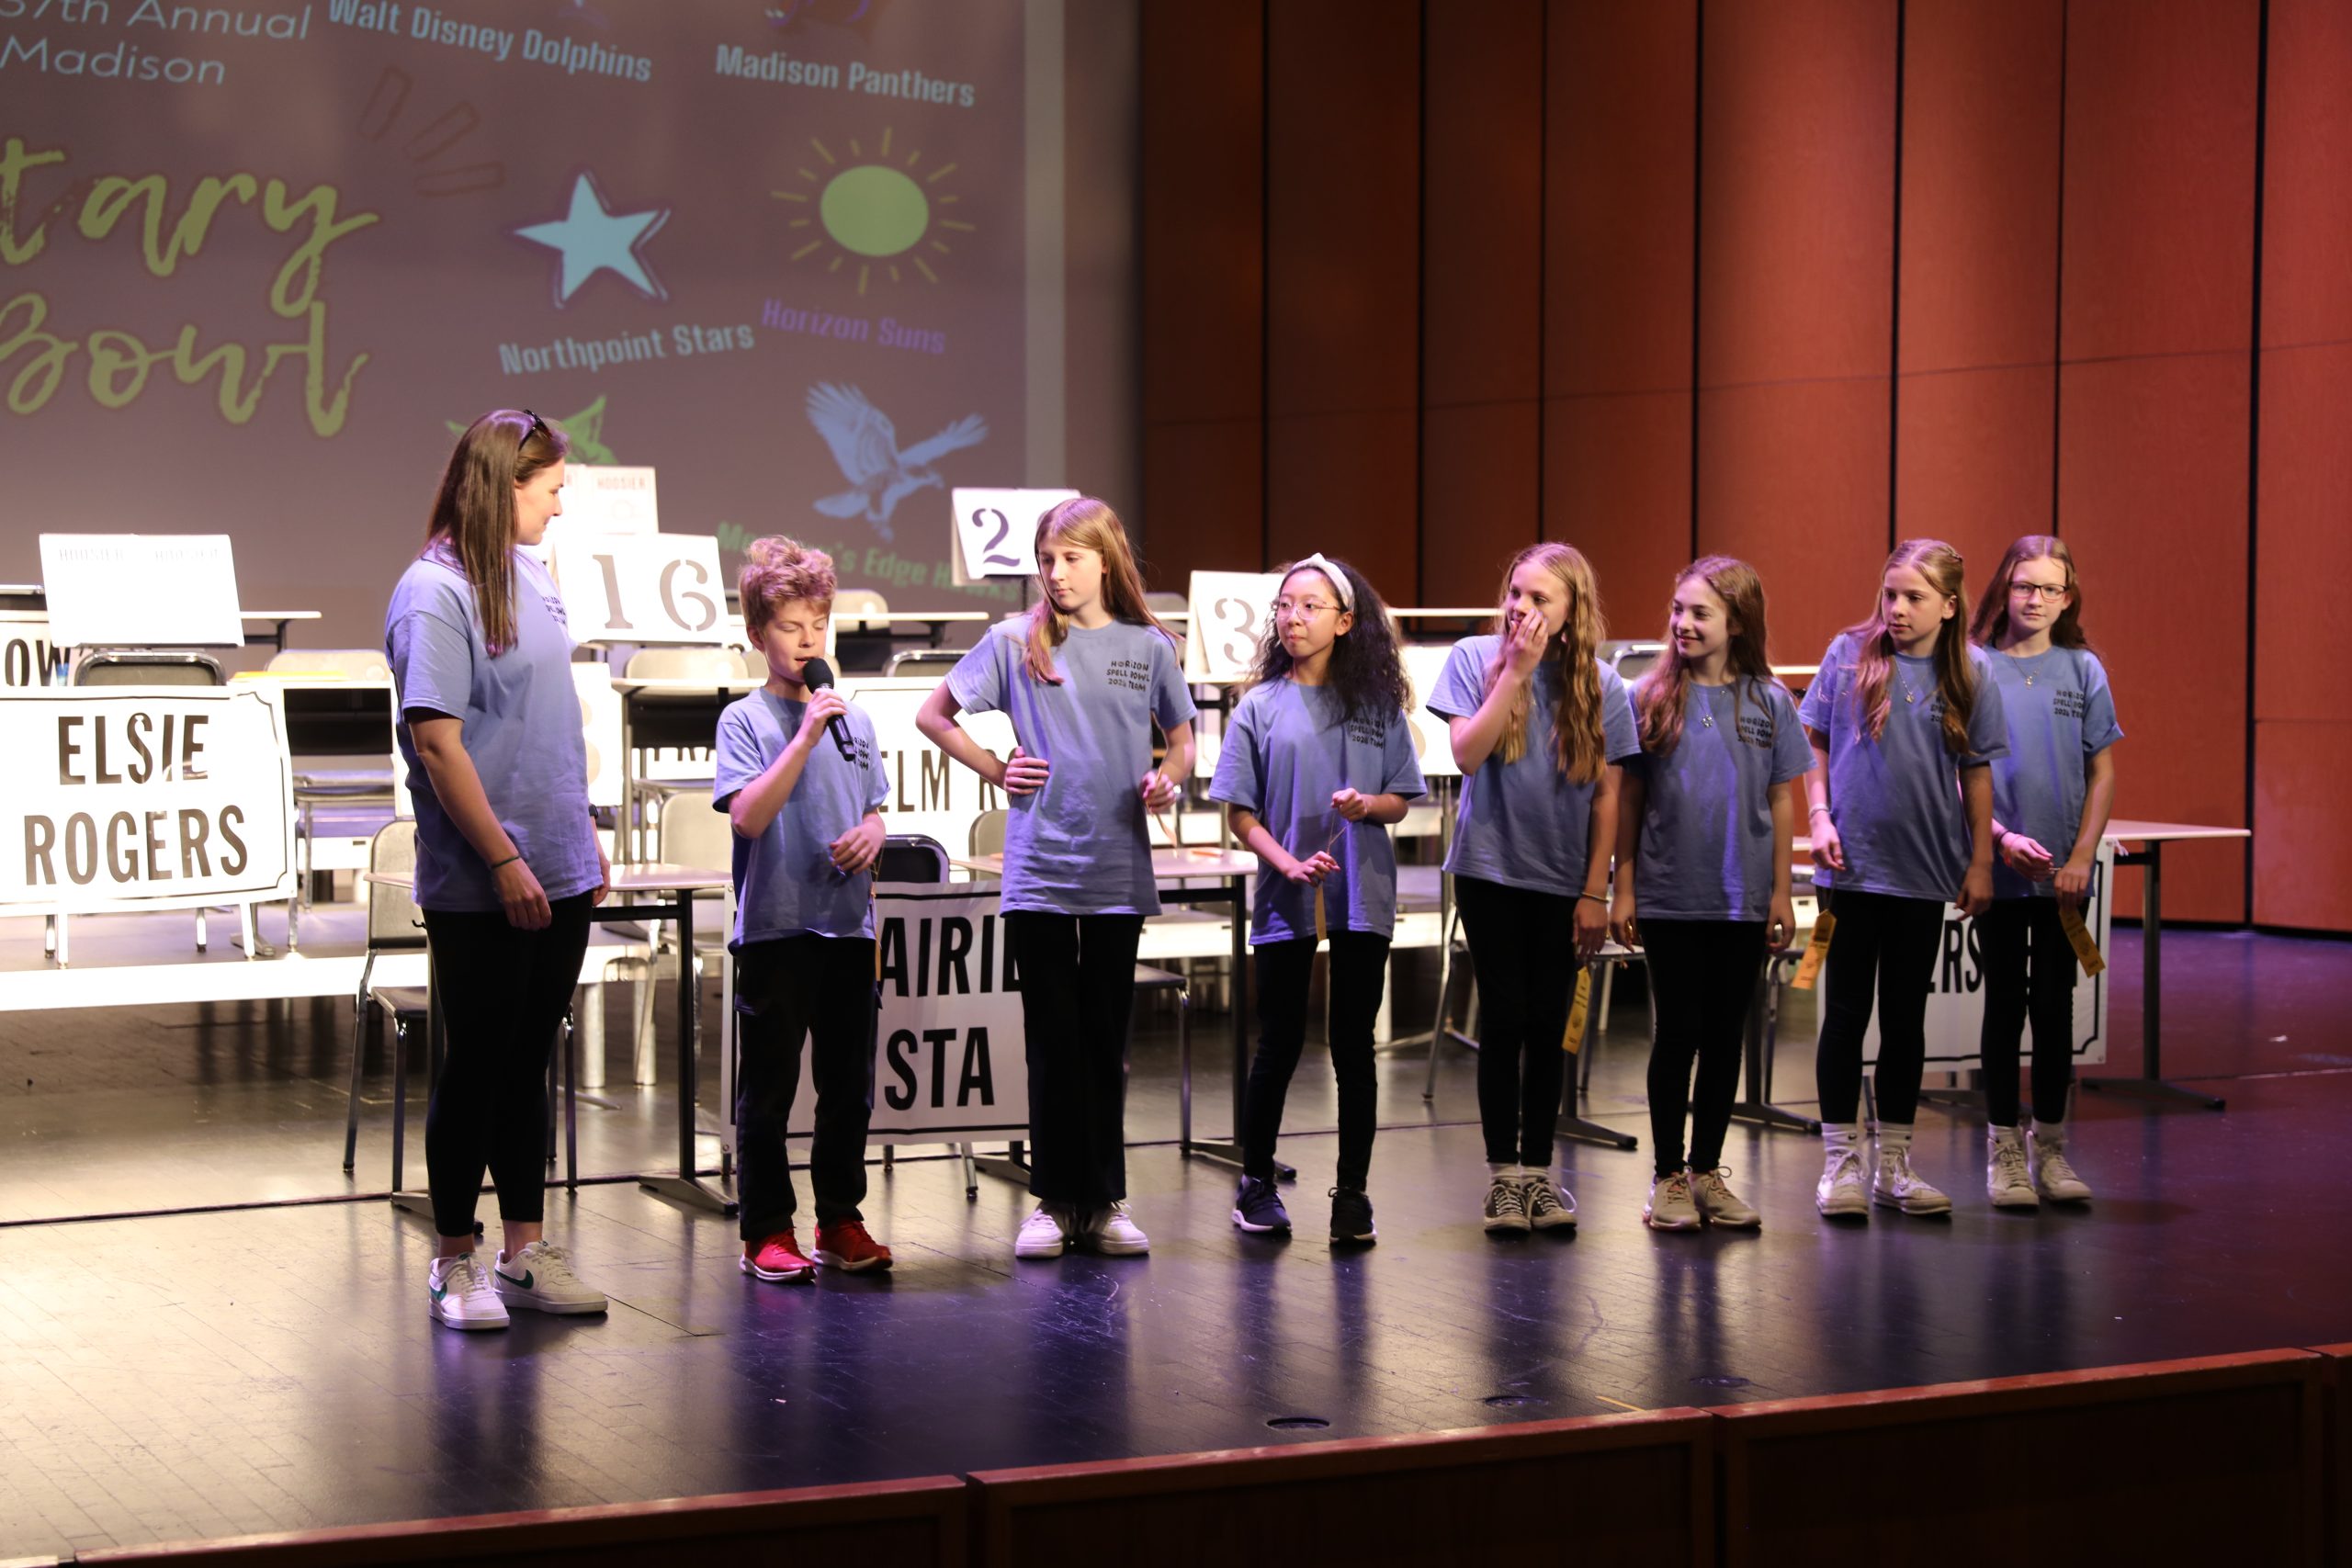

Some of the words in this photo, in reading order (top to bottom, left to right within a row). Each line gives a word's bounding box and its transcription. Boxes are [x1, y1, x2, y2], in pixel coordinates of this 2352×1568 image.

[127, 0, 312, 39] Annual
[328, 0, 401, 34] Walt
[411, 7, 514, 62] Disney
[522, 28, 652, 82] Dolphins
[0, 35, 226, 85] Madison
[716, 44, 839, 89] Madison
[847, 61, 975, 107] Panthers
[499, 328, 668, 375] Northpoint
[673, 323, 754, 356] Stars
[762, 298, 869, 343] Horizon
[877, 317, 945, 355] Suns
[971, 507, 1022, 567] 2
[592, 554, 717, 632] 16
[863, 547, 928, 588] Edge
[1214, 597, 1259, 665] 3
[1106, 669, 1128, 677] SPELL
[1128, 680, 1147, 692] TEAM
[2055, 690, 2084, 700] HORIZO
[58, 712, 209, 785] ELSIE
[1740, 716, 1771, 728] HORIZO
[24, 804, 248, 886] ROGERS
[879, 914, 1023, 998] AIRI
[1929, 919, 1983, 994] RS
[884, 1027, 996, 1111] STA
